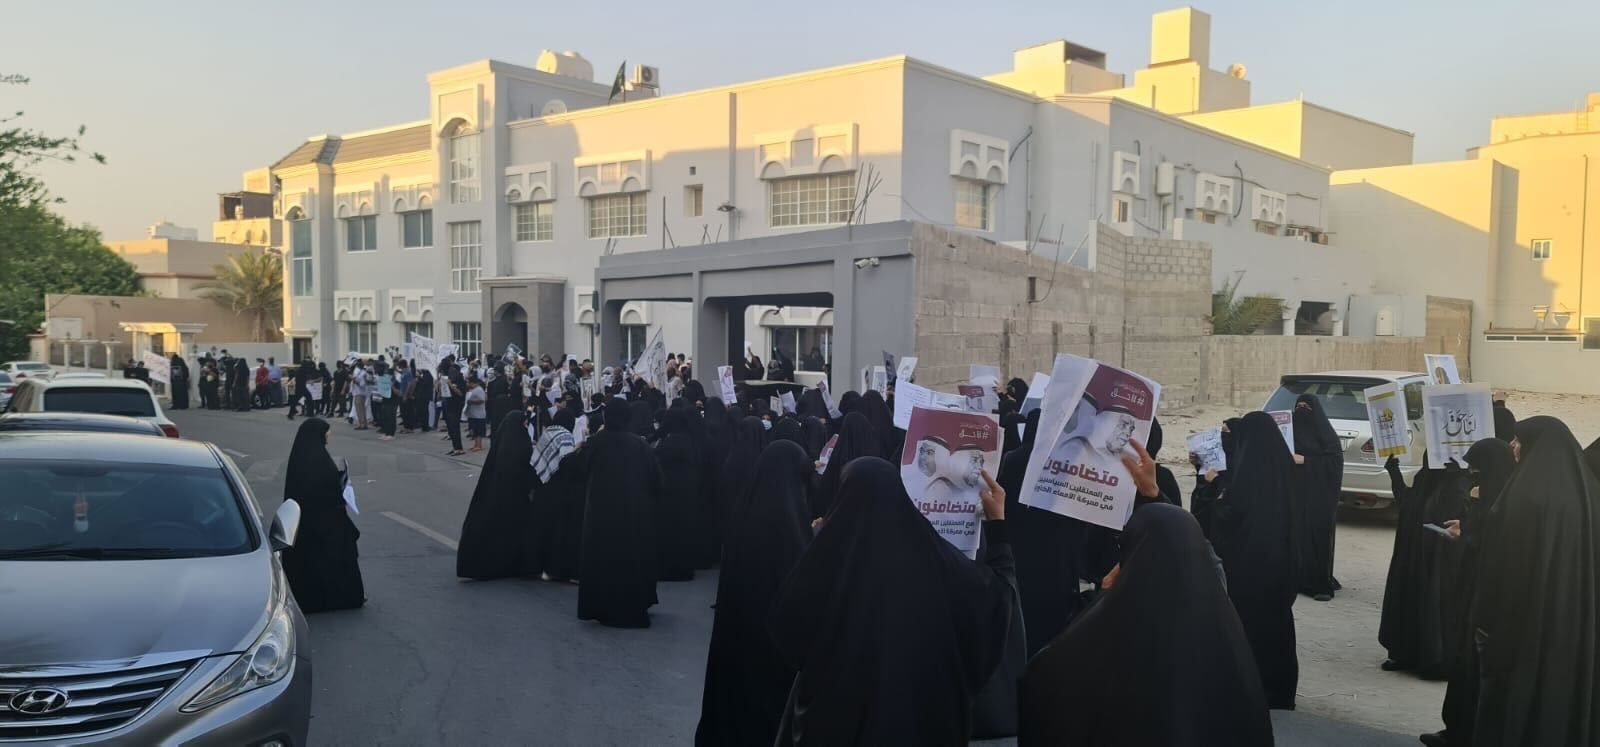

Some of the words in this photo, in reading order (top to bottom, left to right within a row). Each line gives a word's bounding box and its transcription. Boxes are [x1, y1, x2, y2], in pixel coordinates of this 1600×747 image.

[1043, 456, 1119, 487] متضامنون
[1102, 494, 1114, 502] مع
[1099, 503, 1113, 511] في
